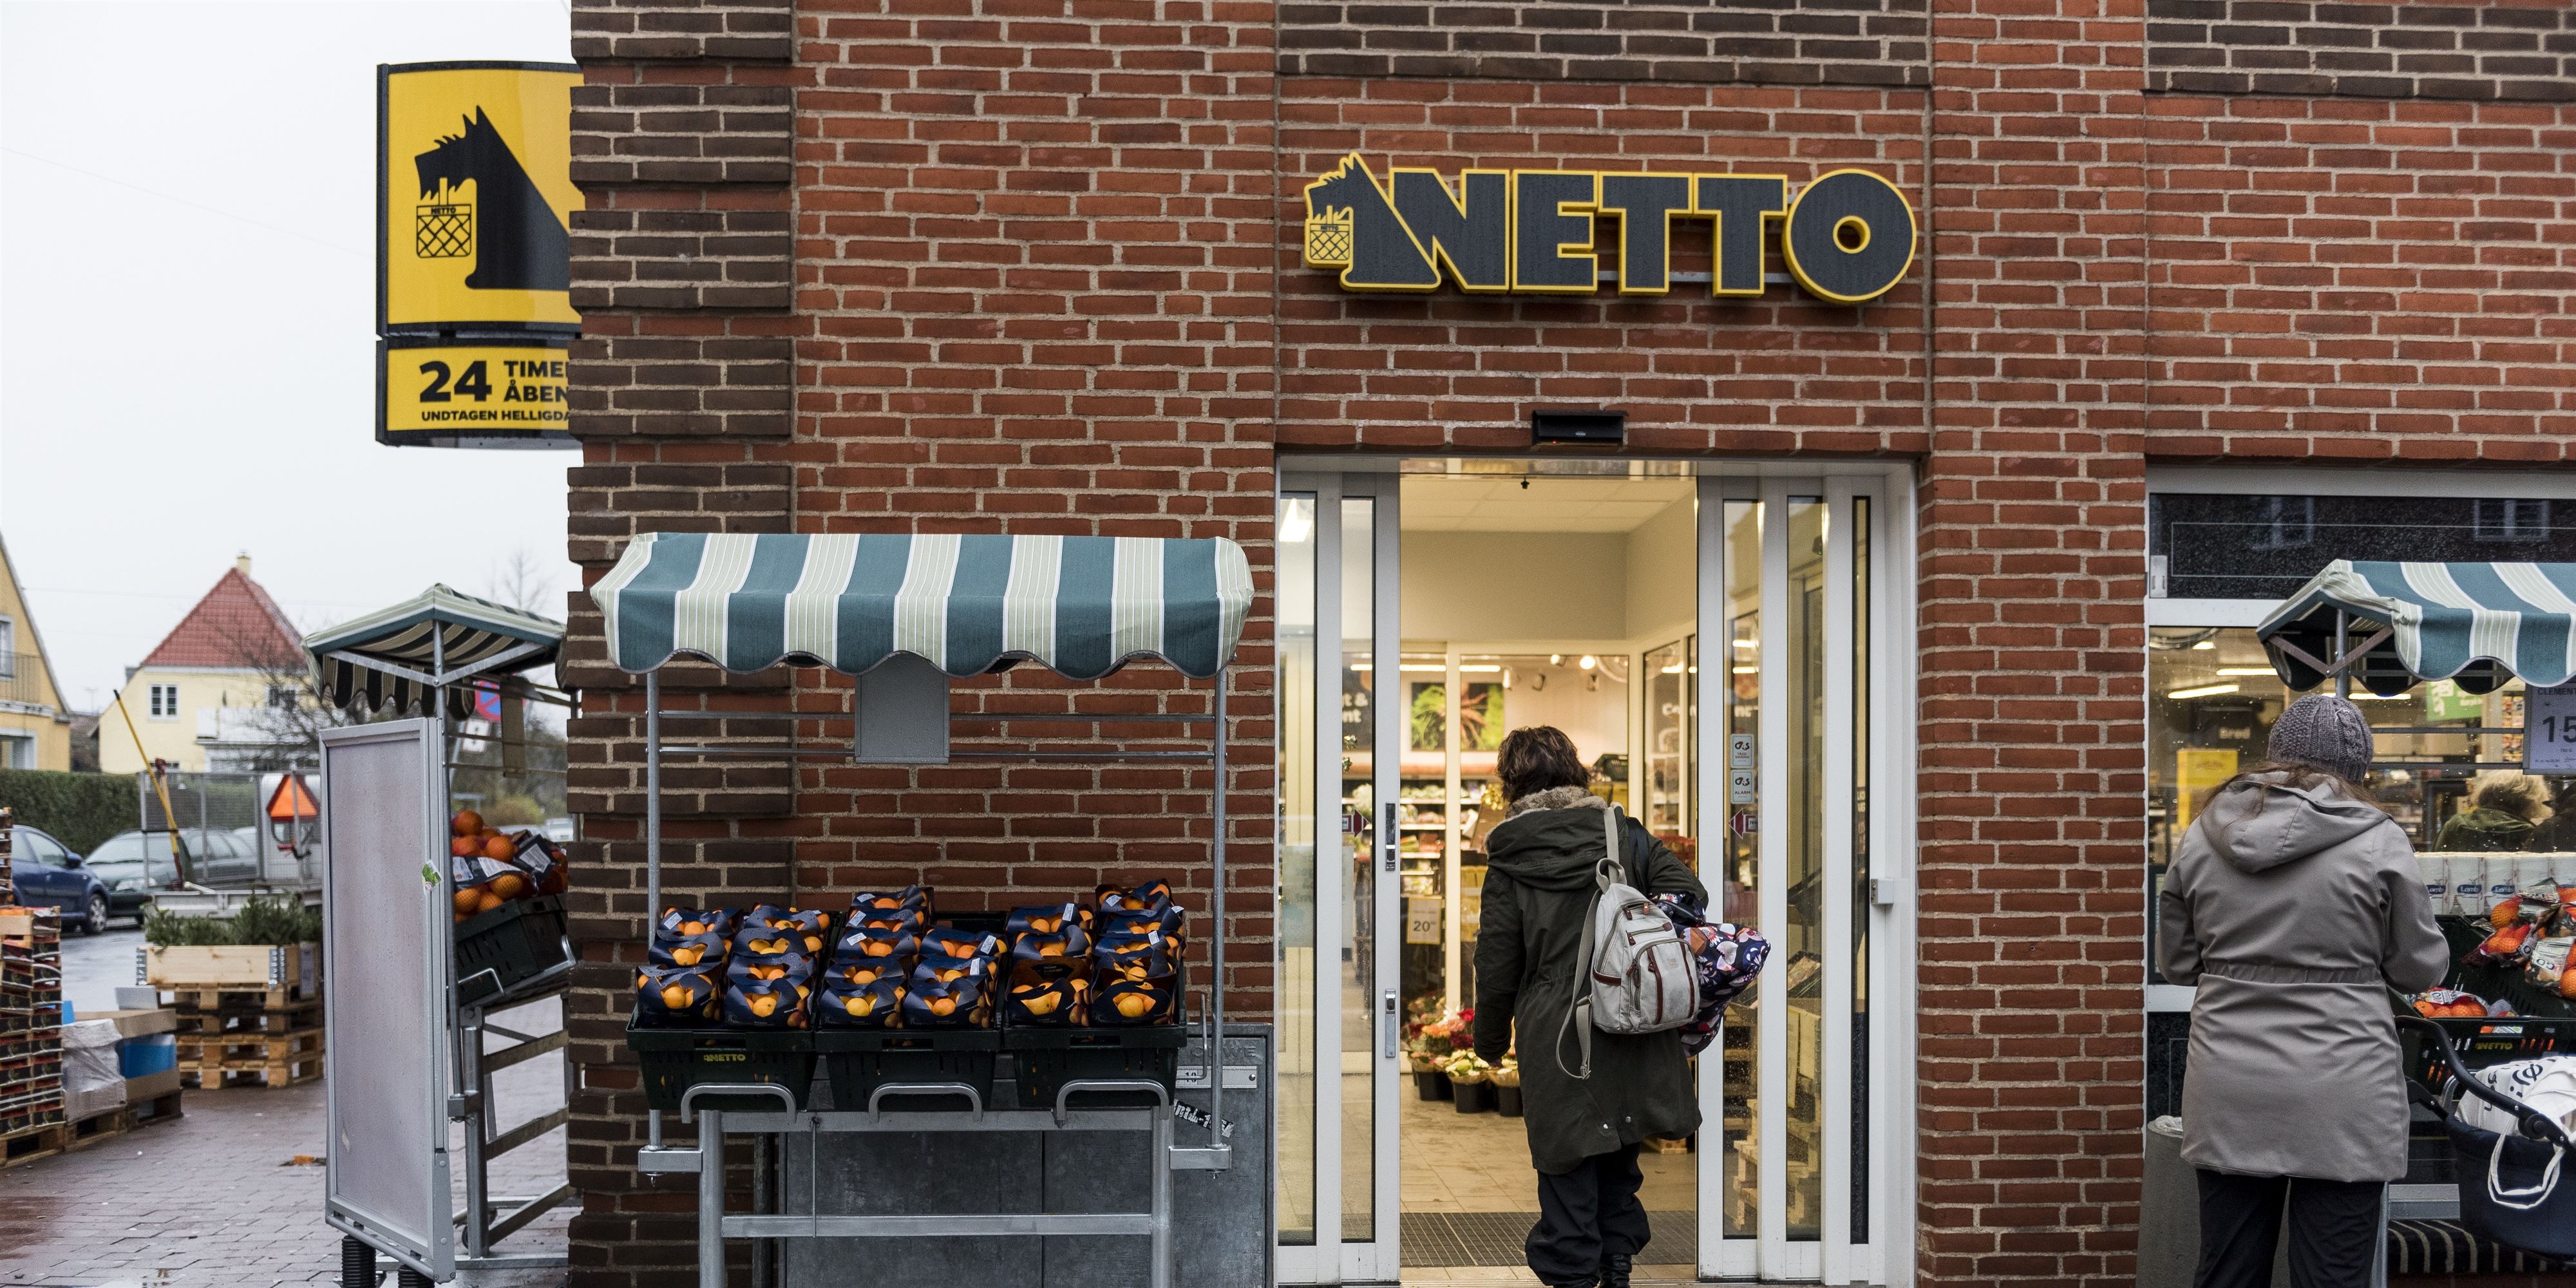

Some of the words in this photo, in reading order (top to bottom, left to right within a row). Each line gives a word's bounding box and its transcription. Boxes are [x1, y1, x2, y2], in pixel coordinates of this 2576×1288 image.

[1389, 168, 1917, 303] NETTO
[419, 361, 492, 402] 24
[504, 361, 569, 377] TIME
[422, 410, 497, 421] UNDTAGEN
[2543, 715, 2576, 743] 15
[708, 1054, 746, 1062] NETTO
